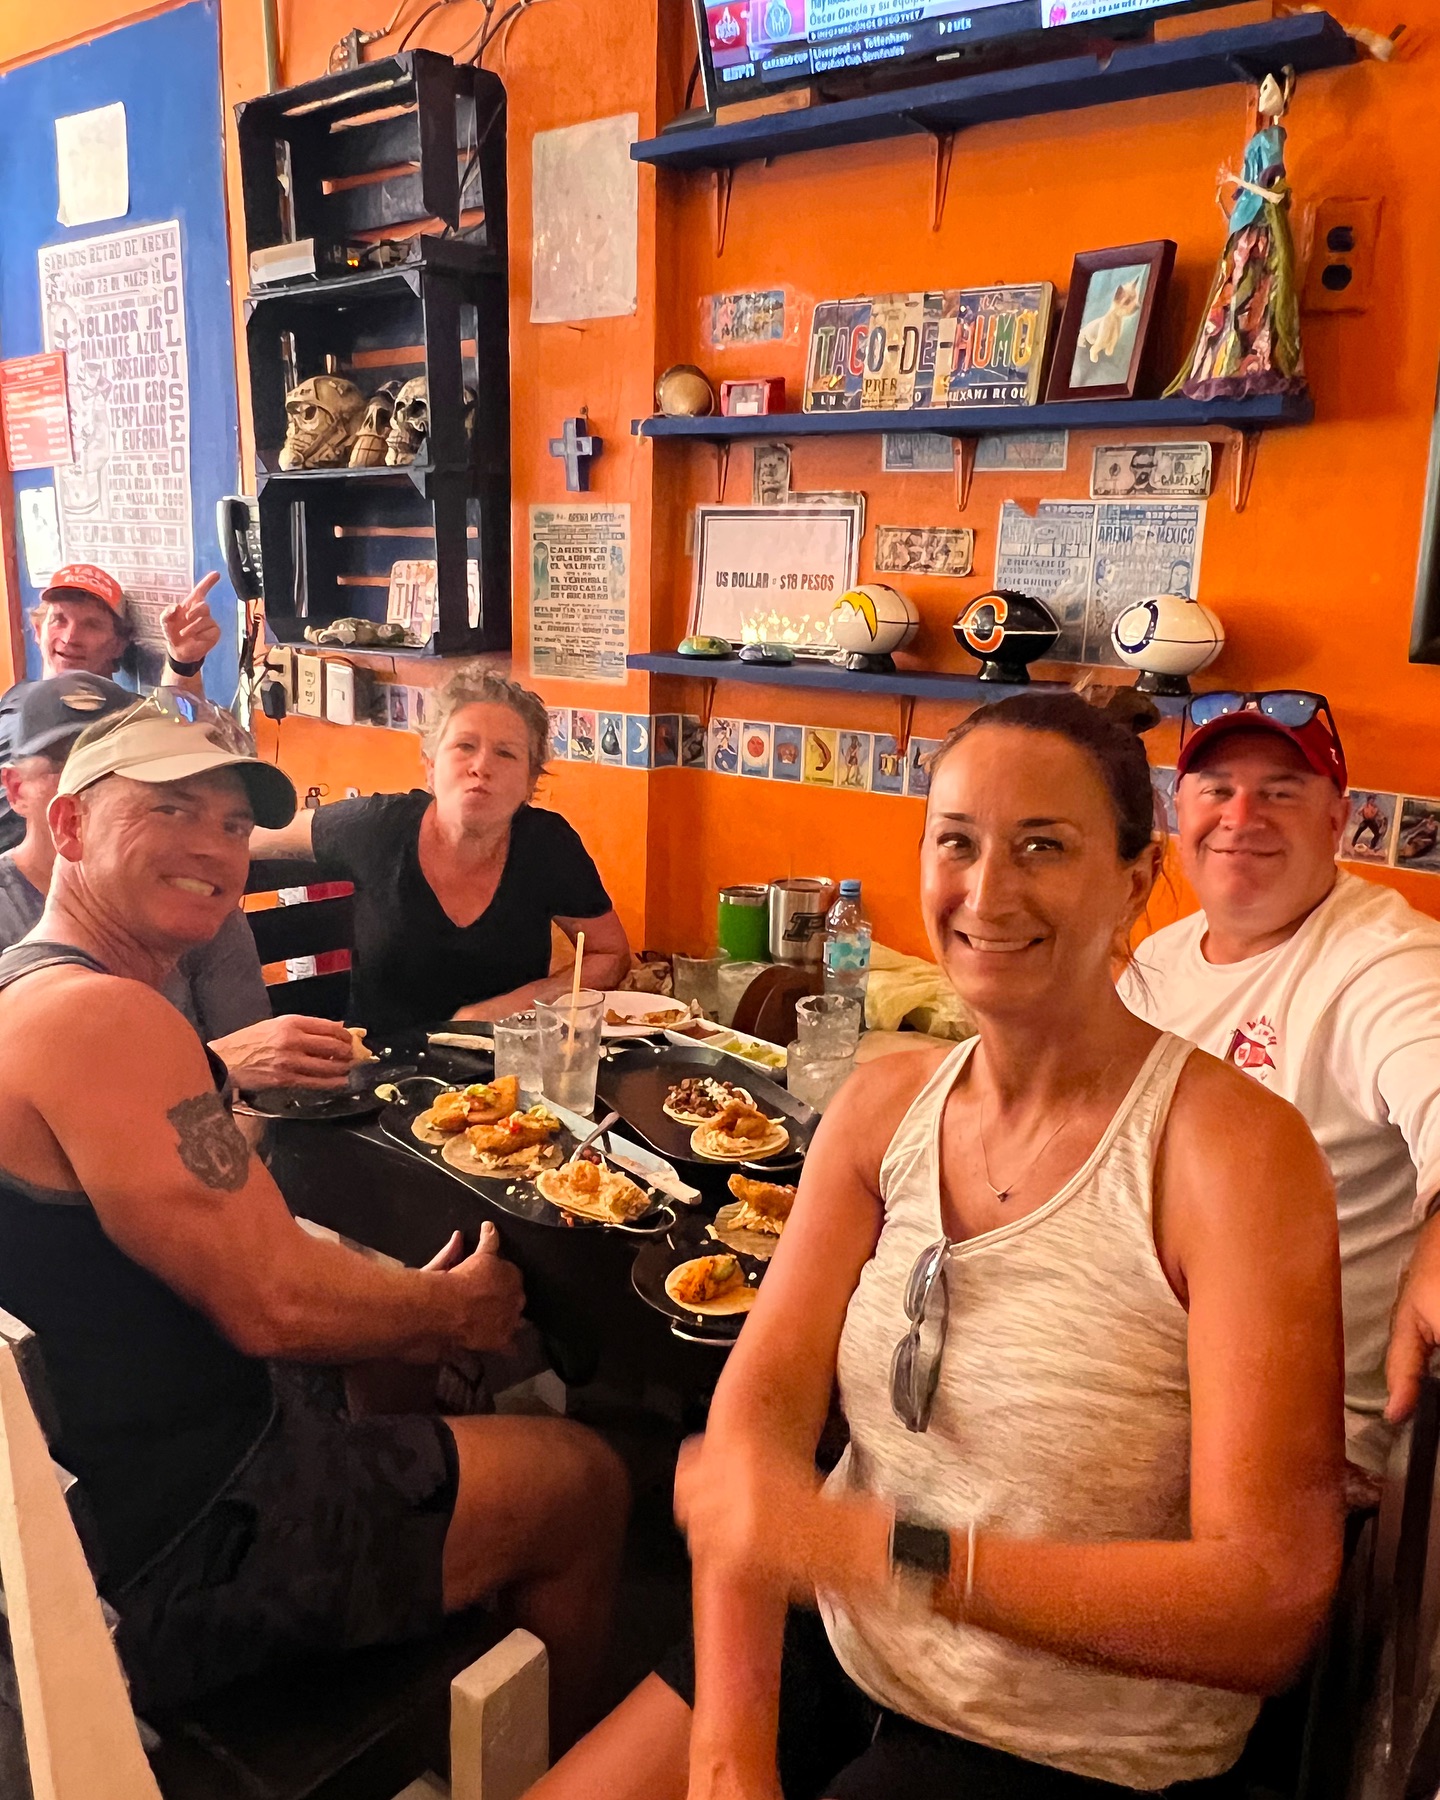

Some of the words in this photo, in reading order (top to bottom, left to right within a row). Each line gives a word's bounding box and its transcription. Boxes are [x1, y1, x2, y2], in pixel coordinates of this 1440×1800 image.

[125, 239, 138, 256] DE
[79, 309, 139, 339] VOLADOR
[146, 306, 163, 331] JR
[136, 331, 165, 355] AZUL
[161, 253, 187, 473] COLISEO
[110, 404, 167, 428] TEMPLARIO
[122, 427, 169, 450] EUFORIA
[1097, 525, 1133, 544] ARENA
[715, 571, 729, 588] US
[731, 571, 769, 589] DOLLAR
[801, 574, 835, 592] PESOS
